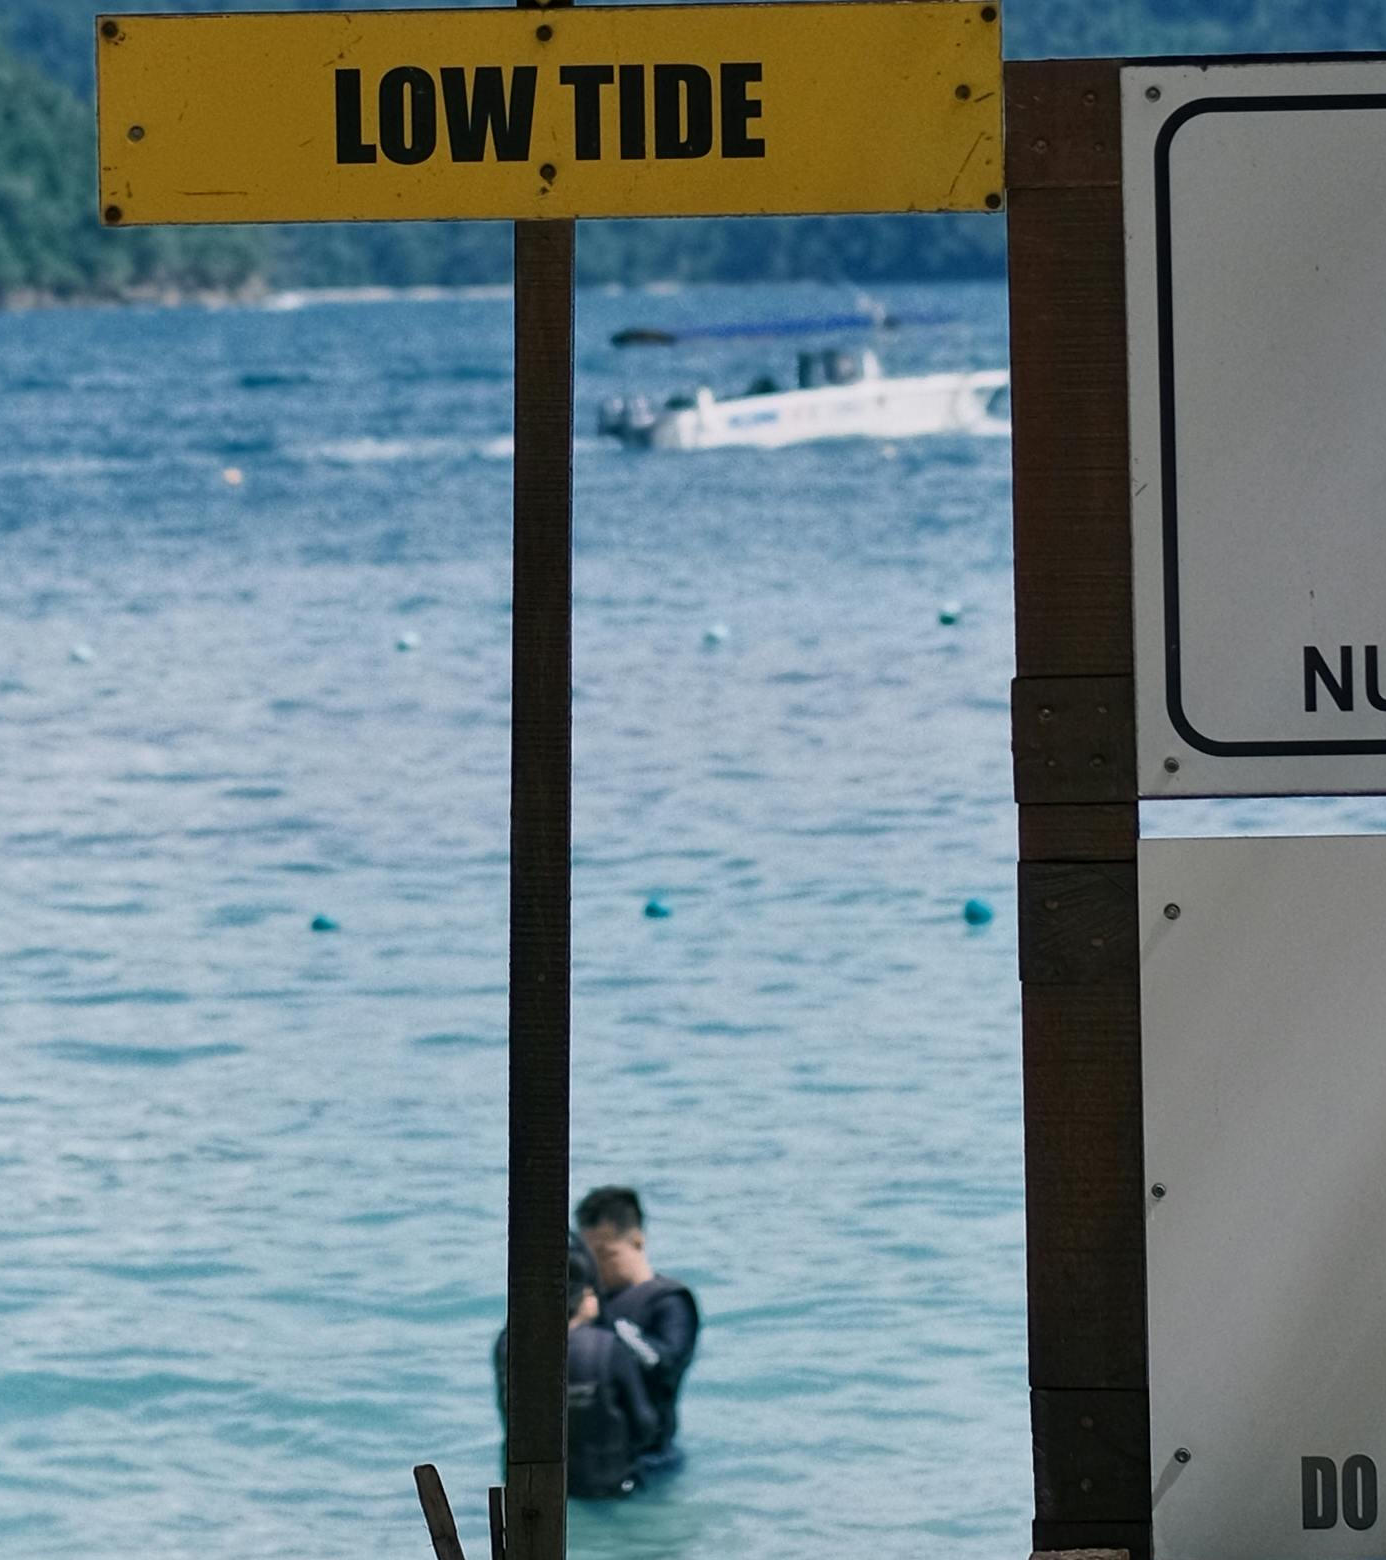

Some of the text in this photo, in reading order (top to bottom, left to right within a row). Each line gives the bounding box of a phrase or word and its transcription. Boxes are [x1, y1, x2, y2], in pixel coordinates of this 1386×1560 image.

[334, 62, 766, 165] LOW TIDE
[1300, 1453, 1378, 1532] DO
